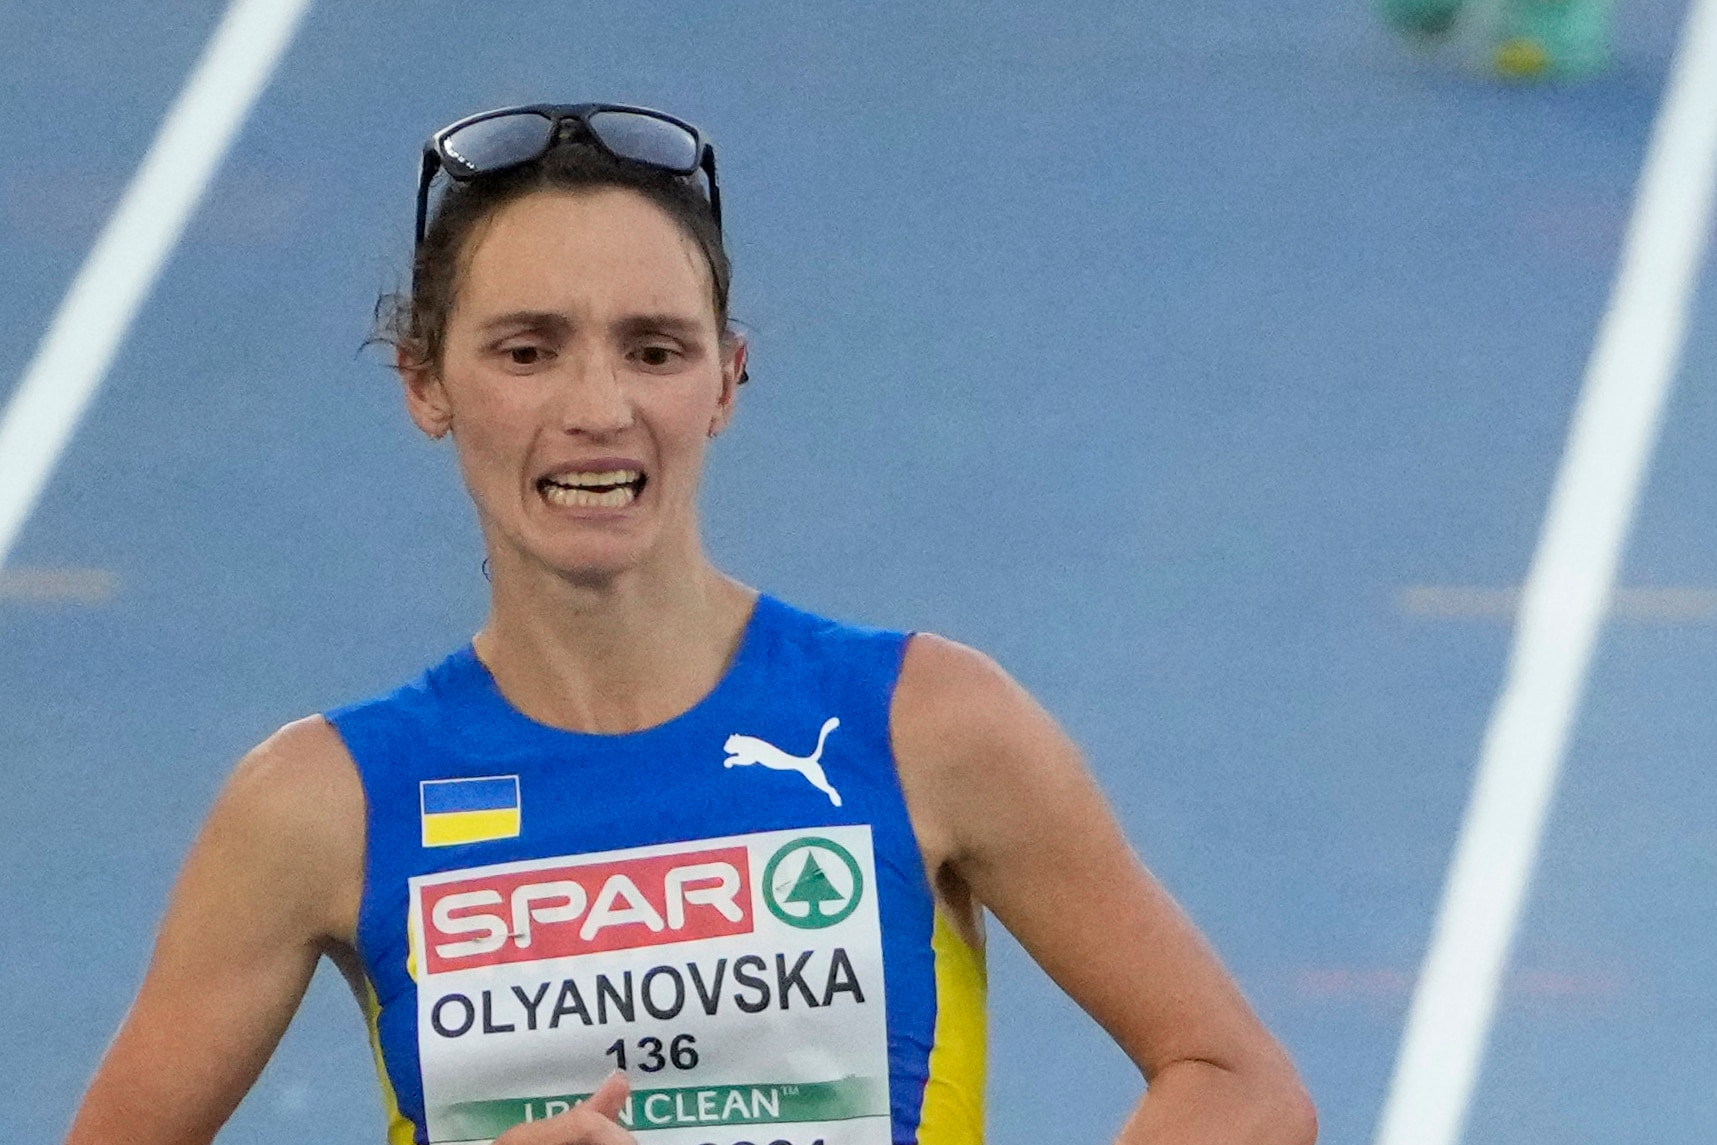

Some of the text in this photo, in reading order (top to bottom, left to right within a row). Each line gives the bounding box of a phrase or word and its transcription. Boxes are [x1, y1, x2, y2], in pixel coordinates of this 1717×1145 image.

[432, 861, 744, 959] SPAR
[431, 947, 866, 1038] OLYANOVSKA
[605, 1033, 699, 1073] 136
